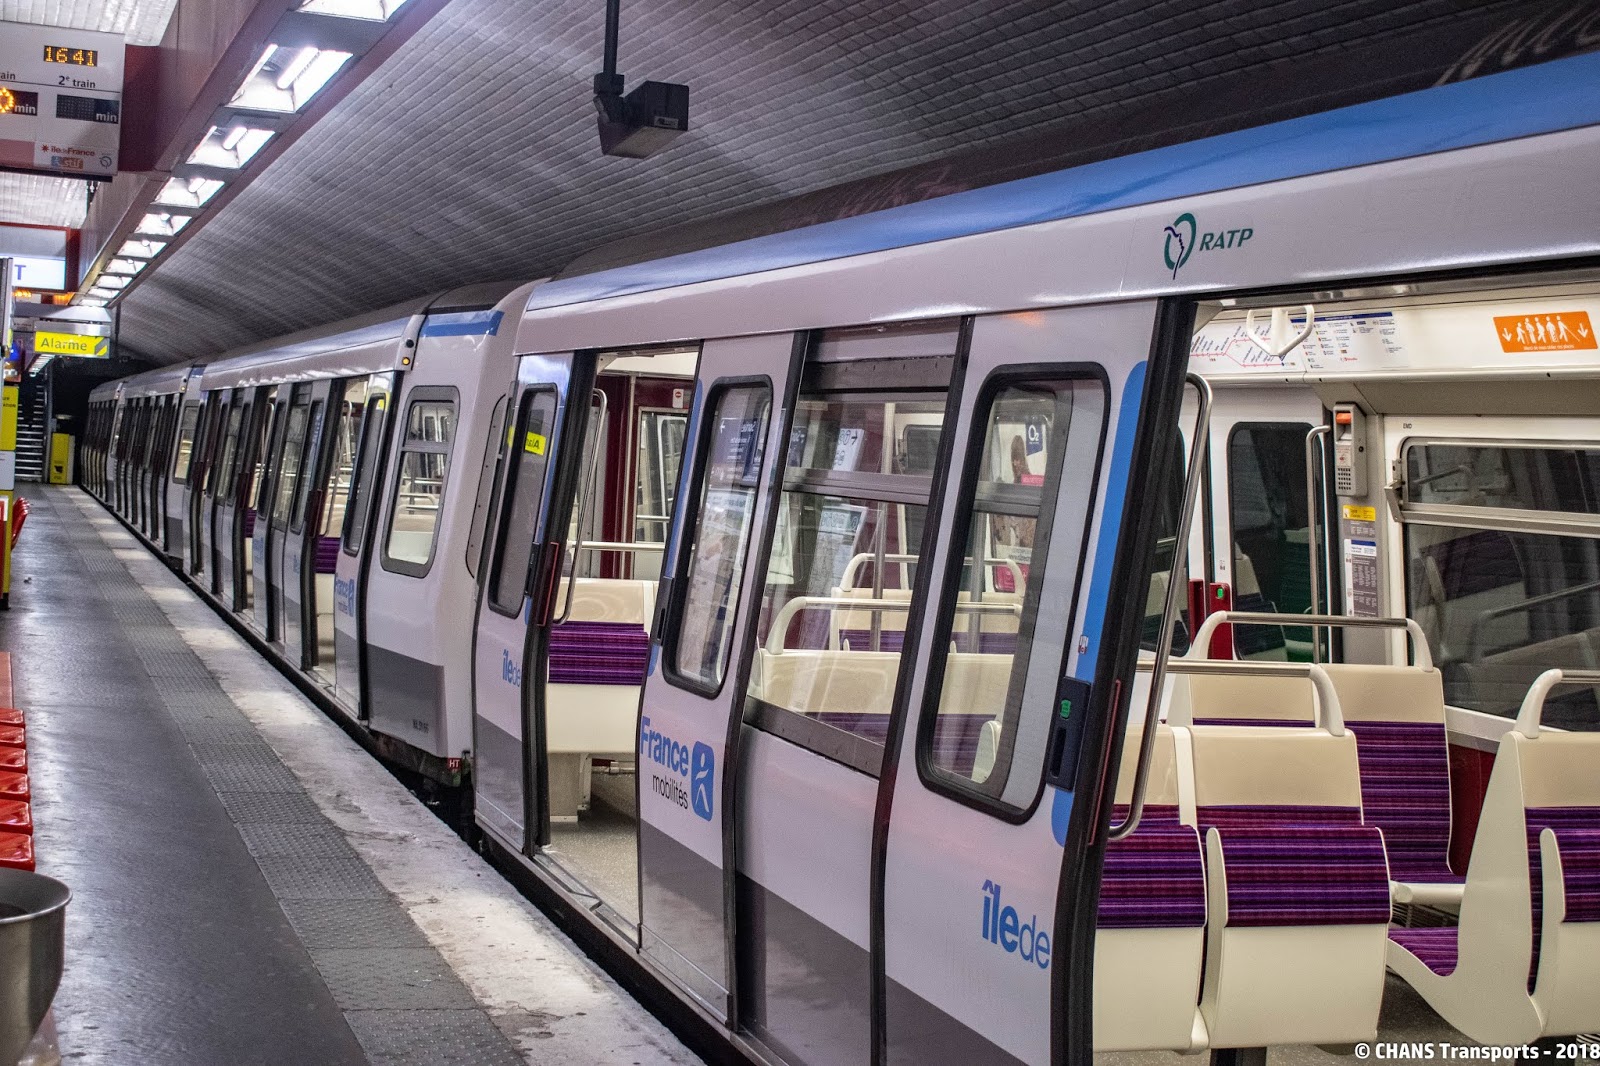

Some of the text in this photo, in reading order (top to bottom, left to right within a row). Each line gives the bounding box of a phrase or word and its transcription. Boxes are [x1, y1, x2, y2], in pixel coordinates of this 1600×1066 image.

[0, 71, 16, 80] ain
[72, 79, 96, 88] train
[14, 103, 36, 115] min
[95, 111, 118, 123] min
[1199, 228, 1254, 252] RATP
[41, 337, 88, 351] Alarme
[640, 715, 689, 777] France
[449, 758, 460, 768] HT
[652, 774, 689, 810] mobilités
